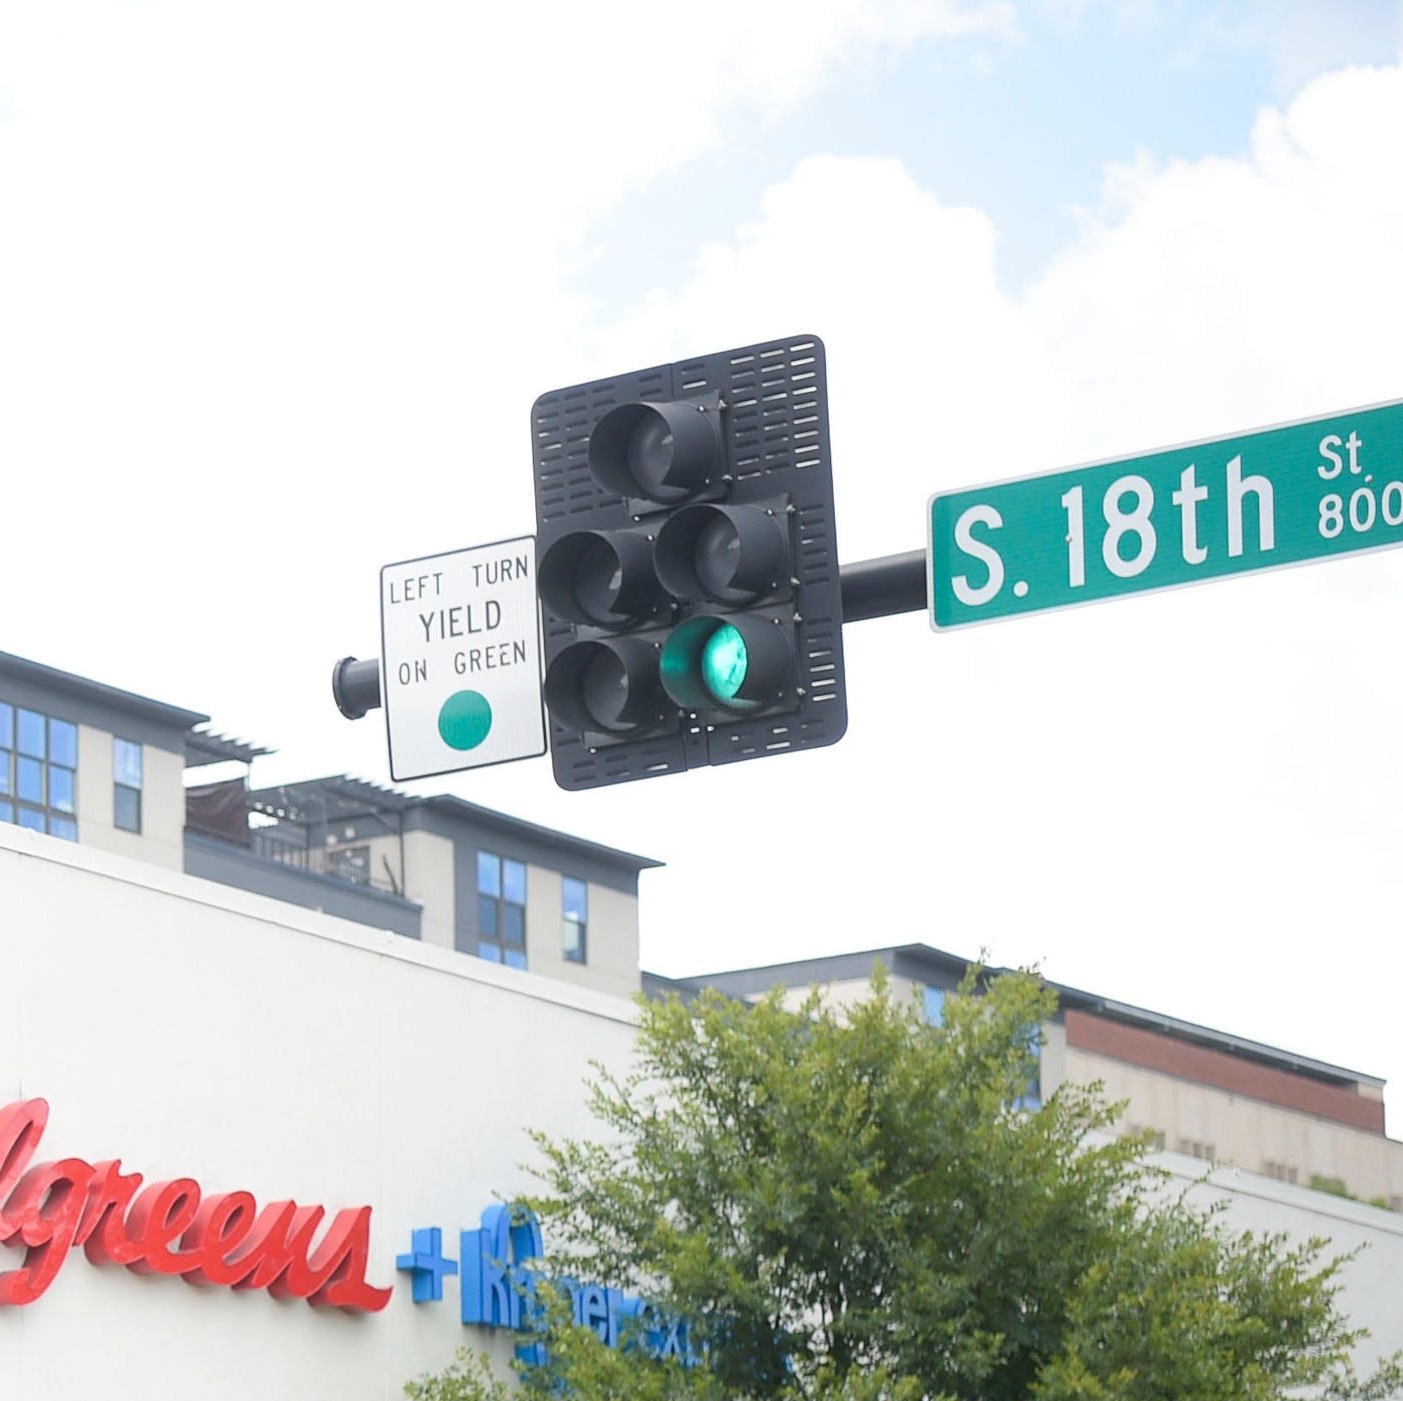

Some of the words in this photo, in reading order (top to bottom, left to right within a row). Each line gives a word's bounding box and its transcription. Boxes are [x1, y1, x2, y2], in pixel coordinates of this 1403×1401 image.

[1317, 430, 1362, 480] St
[951, 504, 1029, 606] S.
[1061, 454, 1275, 588] 18th
[1318, 481, 1403, 539] 800
[390, 572, 443, 604] LEFT
[472, 555, 528, 587] TURN
[419, 600, 502, 642] YIELD
[398, 659, 427, 685] ON
[454, 640, 526, 675] GREEN
